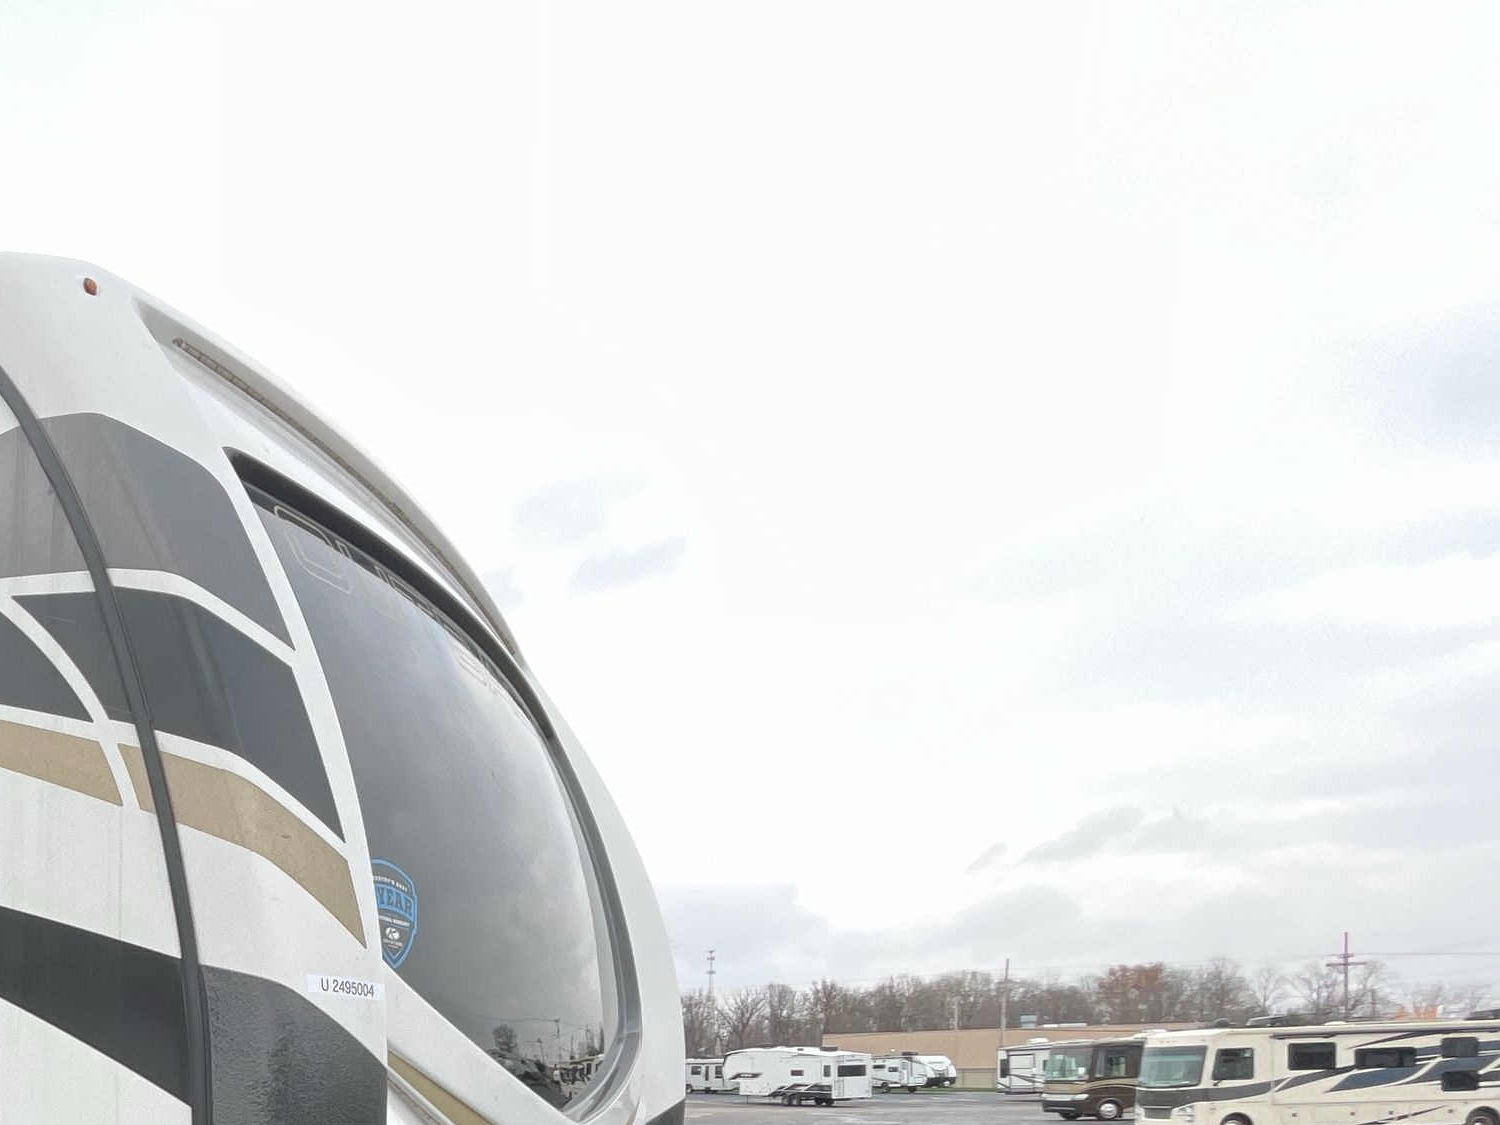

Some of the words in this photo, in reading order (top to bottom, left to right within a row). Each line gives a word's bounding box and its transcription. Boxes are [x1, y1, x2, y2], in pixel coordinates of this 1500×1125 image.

[375, 886, 412, 916] YEAR
[320, 977, 329, 992] U
[332, 979, 374, 997] 2495004
